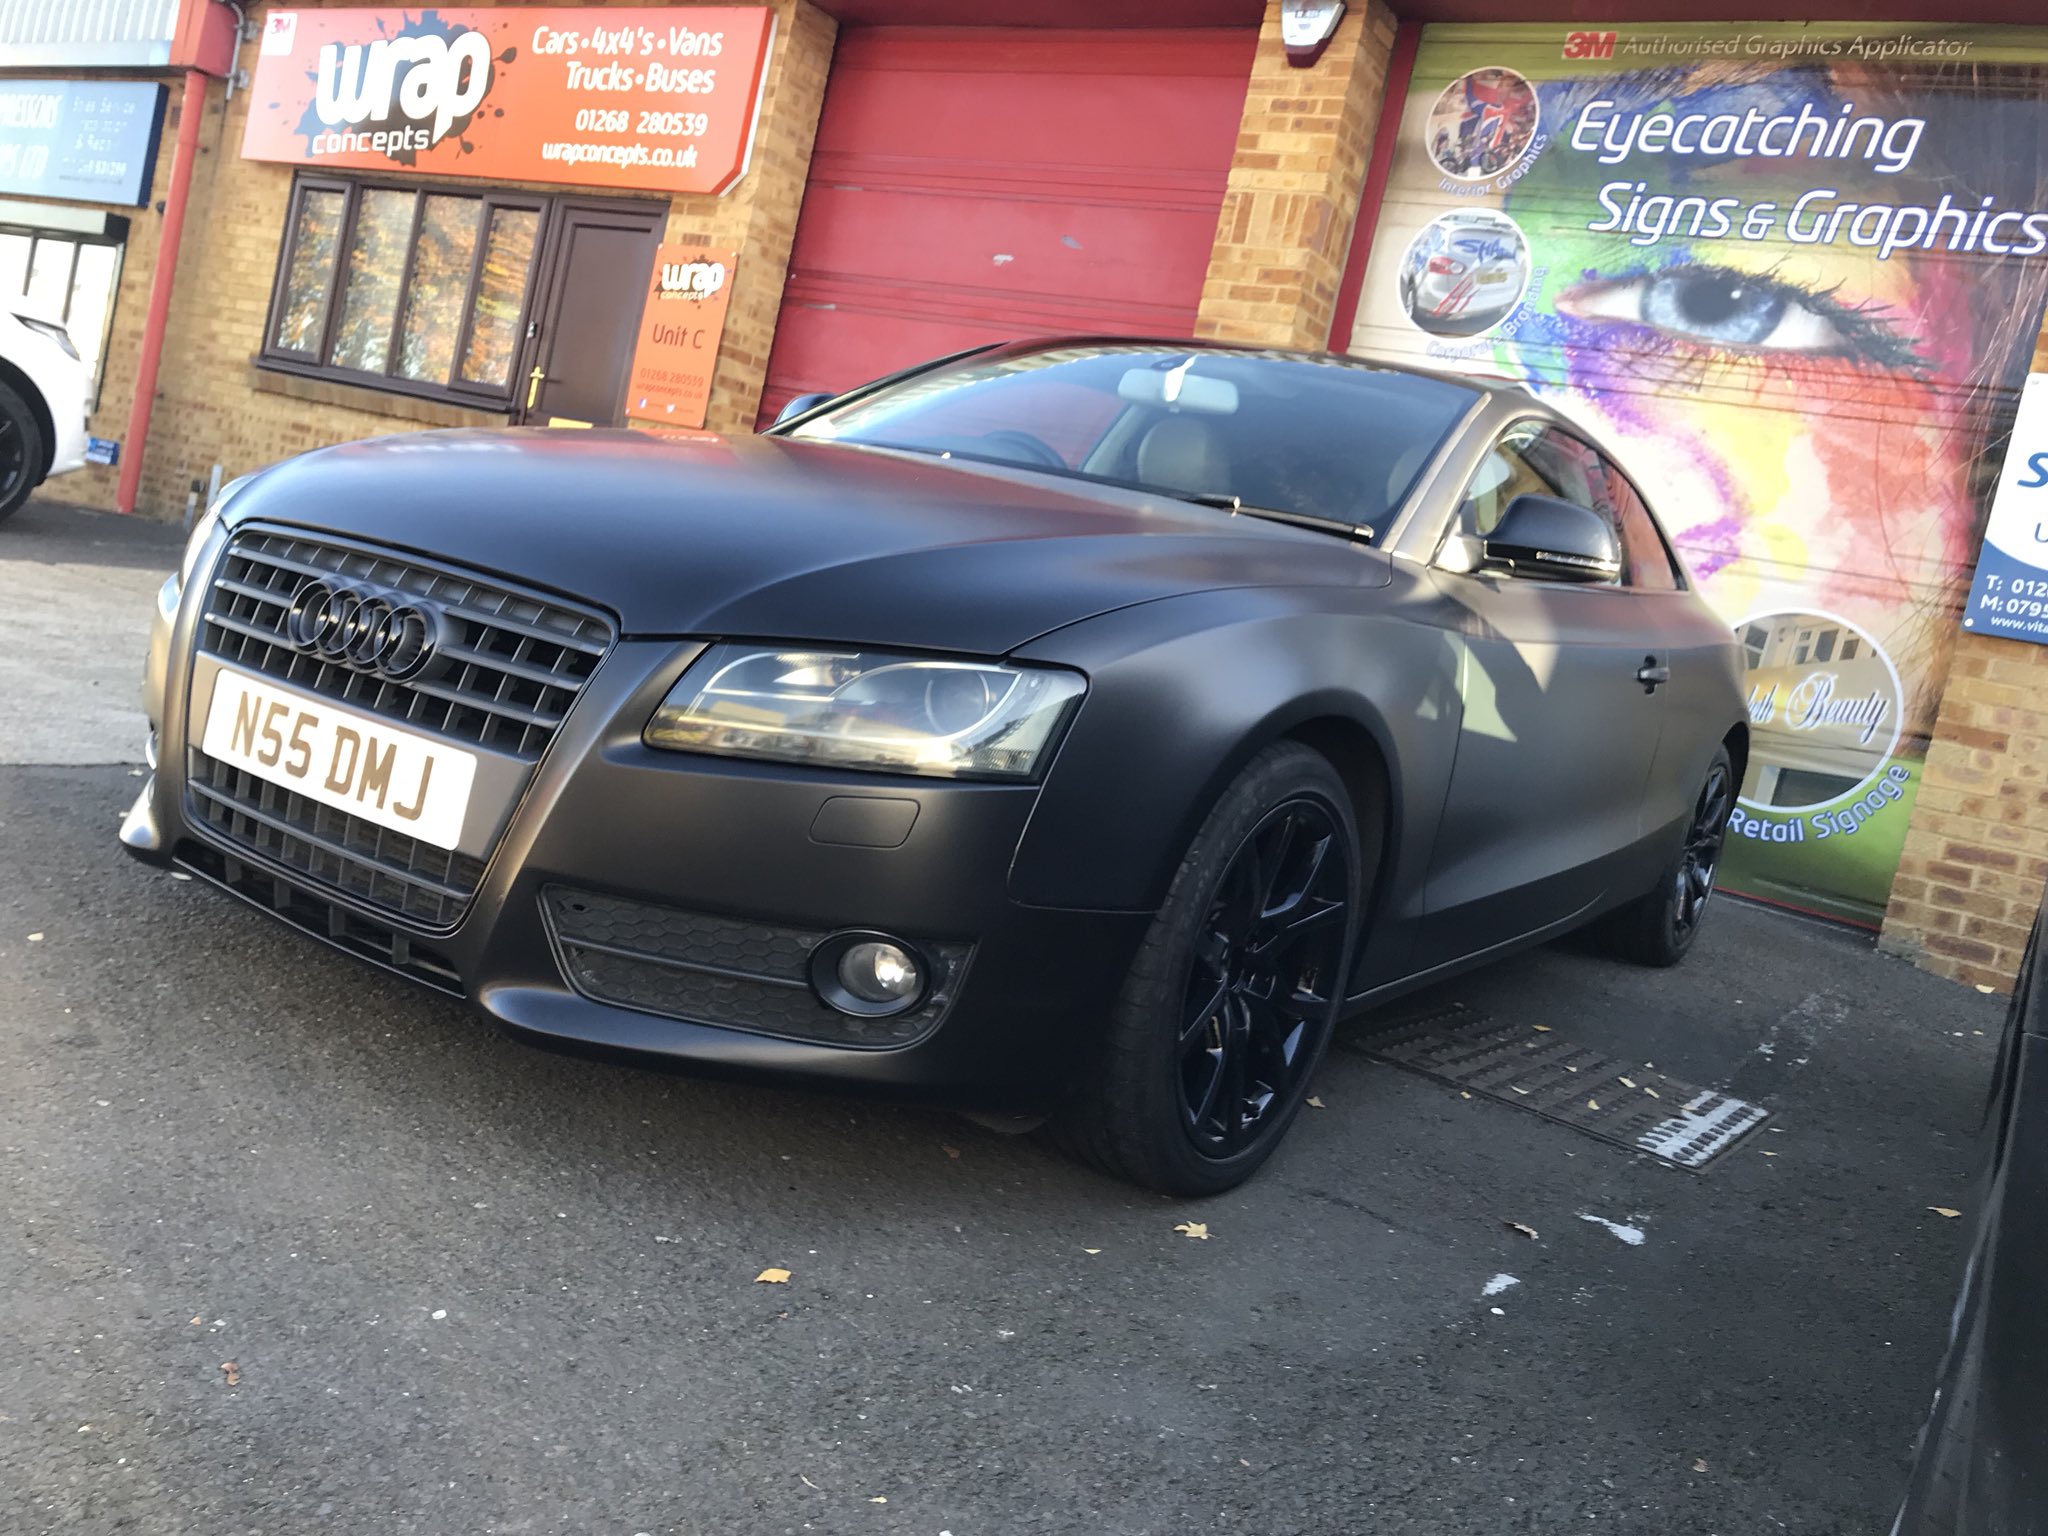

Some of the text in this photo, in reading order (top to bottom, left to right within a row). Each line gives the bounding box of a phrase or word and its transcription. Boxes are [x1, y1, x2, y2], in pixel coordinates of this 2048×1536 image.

[532, 26, 724, 56] Cars 4x4's Vans
[1563, 31, 1973, 60] 3M Authorised Graphics Applicator
[316, 31, 491, 144] wrap
[566, 60, 716, 94] Trucks Buses
[575, 109, 708, 136] 01268 280539
[1570, 100, 1925, 173] Eyecatching
[312, 125, 431, 157] concepts
[542, 142, 698, 169] wrapconcepts.co.uk
[1439, 134, 1547, 197] Interior Graphics
[1588, 182, 2048, 260] Signs & Graphics
[661, 263, 725, 298] wrap
[1503, 266, 1549, 335] Branding
[652, 323, 705, 349] Unit C
[1986, 574, 2048, 598] T: 012
[1785, 672, 1890, 745] Beauty
[231, 691, 434, 821] N55 DMJ
[1726, 764, 1910, 842] Retail Signage
